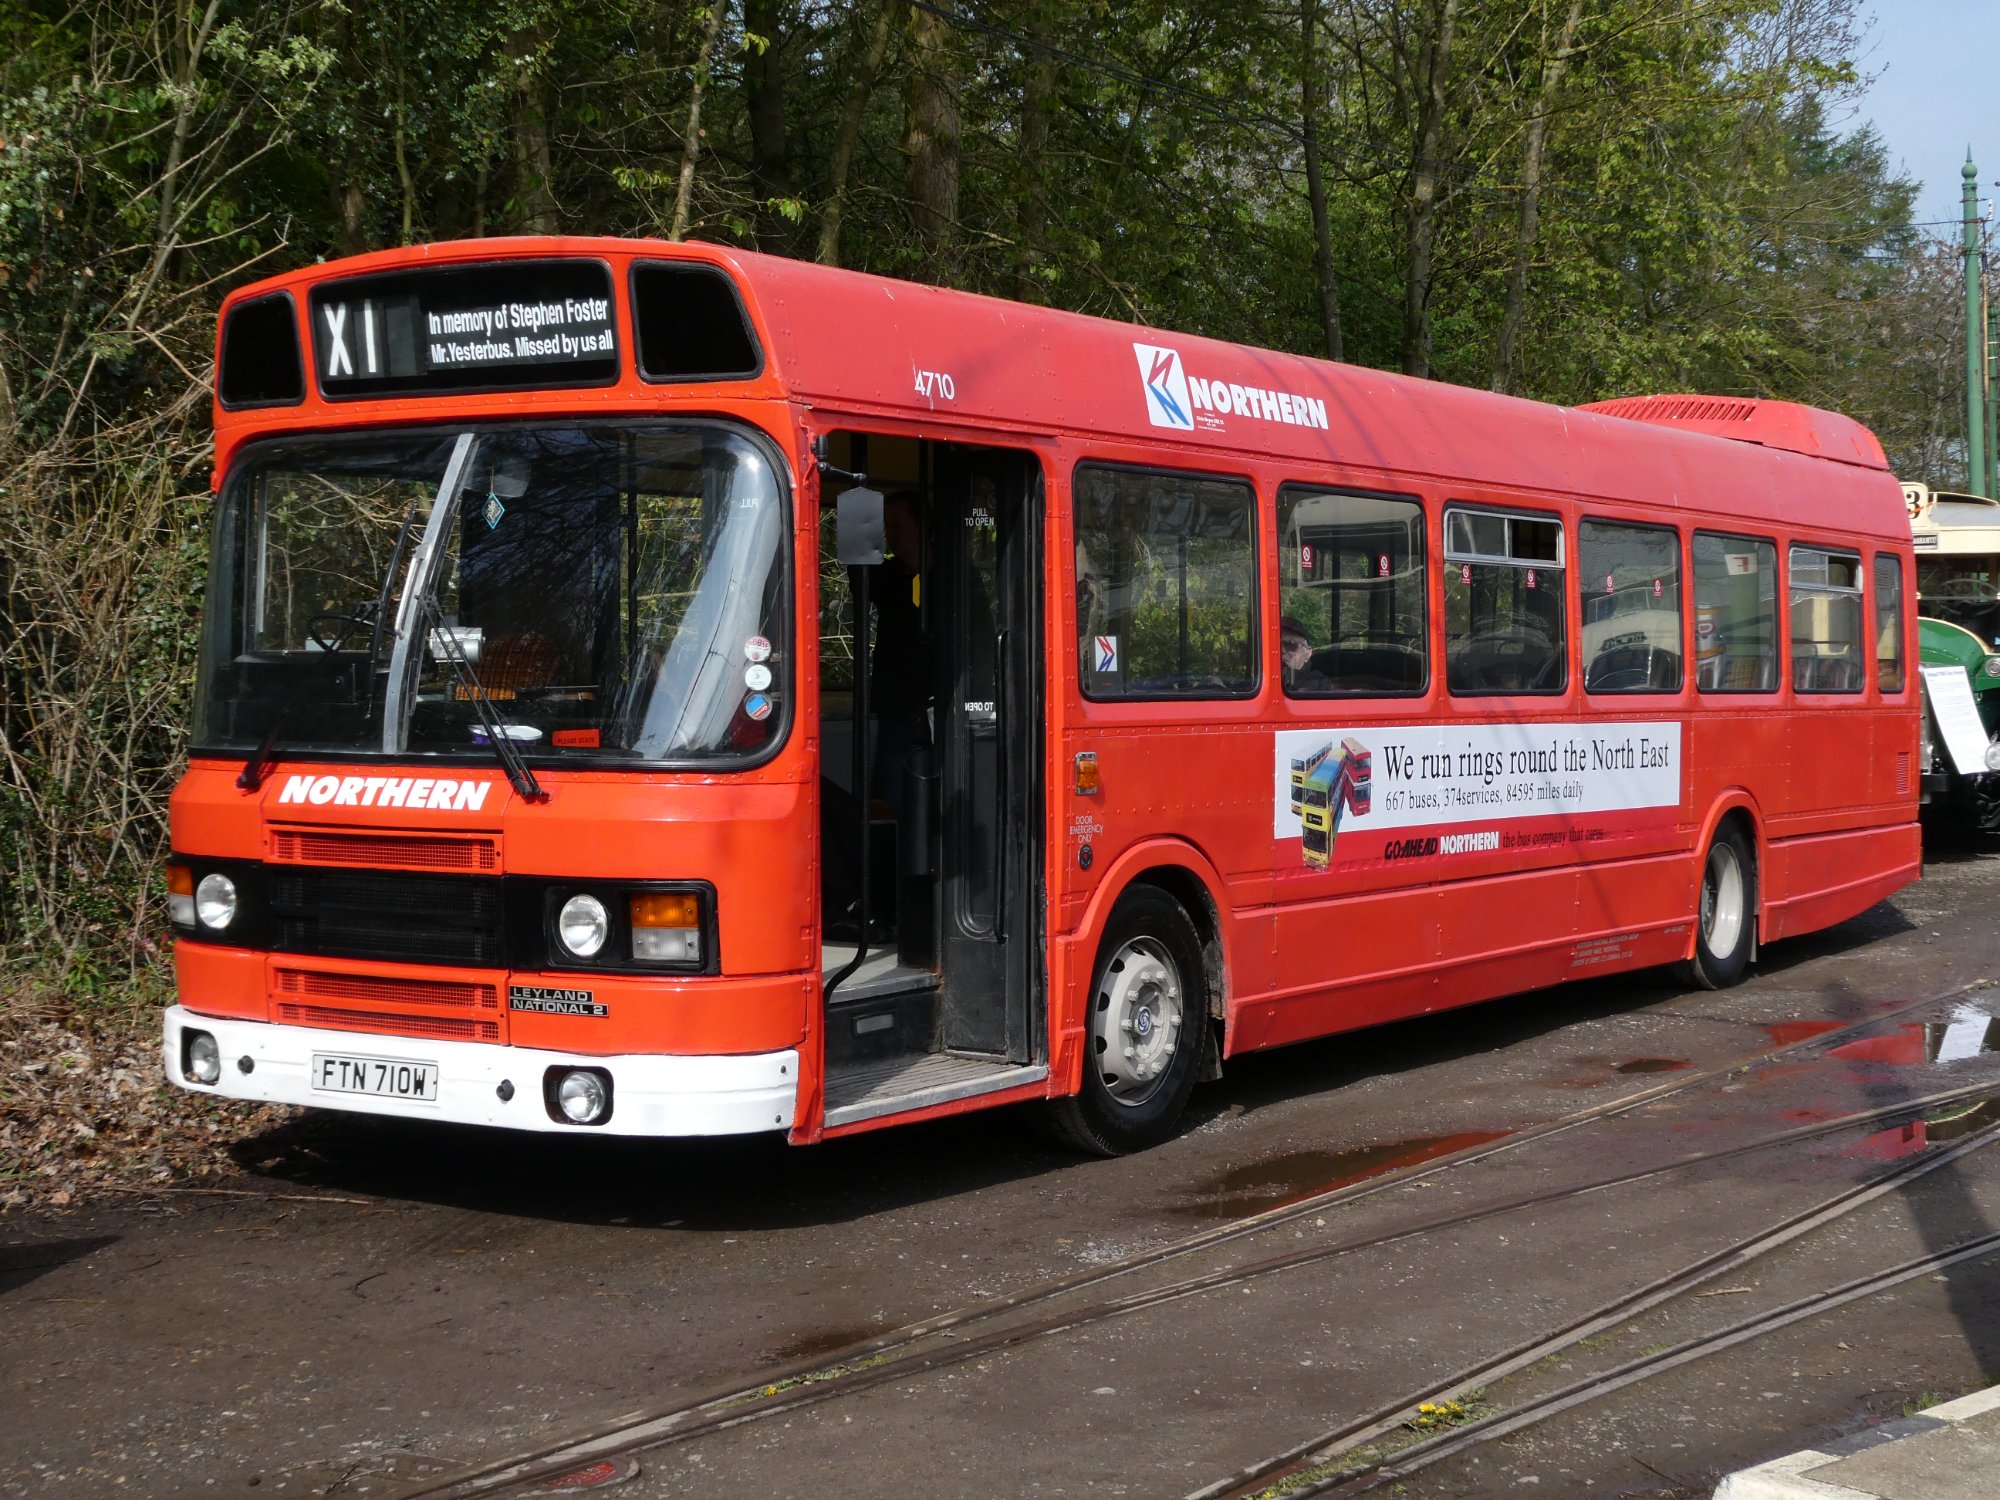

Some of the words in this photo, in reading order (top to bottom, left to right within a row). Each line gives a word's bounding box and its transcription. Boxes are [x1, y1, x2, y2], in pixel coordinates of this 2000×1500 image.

[428, 311, 441, 335] In
[444, 310, 492, 336] memory
[495, 304, 509, 329] of
[510, 301, 564, 333] Stephen
[565, 297, 608, 323] Foster
[515, 334, 560, 357] Missed
[561, 333, 579, 358] by
[581, 335, 597, 351] us
[599, 329, 614, 350] all
[913, 369, 955, 401] 4710
[1188, 376, 1329, 430] NORTHERN
[965, 517, 974, 527] TO
[975, 517, 995, 526] OPEN
[972, 508, 988, 517] PULL
[1384, 745, 1414, 782] We
[1421, 751, 1452, 780] run
[1458, 742, 1503, 785] rings
[1509, 740, 1557, 775] round
[1564, 739, 1586, 772] the
[1592, 738, 1634, 771] North
[1639, 738, 1669, 769] East
[278, 775, 491, 811] NORTHERN
[1385, 791, 1405, 811] 667
[1408, 791, 1441, 811] buses,
[1506, 783, 1534, 802] 84595
[1537, 780, 1560, 800] miles
[1563, 779, 1584, 802] daily
[1070, 824, 1104, 836] EMERGENCY
[1075, 815, 1093, 825] DOOR
[1078, 834, 1093, 844] ONLY
[1440, 831, 1500, 855] NORTHERN
[1503, 831, 1515, 848] the
[1517, 831, 1531, 846] bus
[1532, 831, 1567, 847] company
[1568, 826, 1584, 842] that
[513, 986, 588, 1002] LEYLAND
[513, 999, 588, 1014] NATIONAL
[593, 1005, 604, 1015] 2
[322, 1059, 366, 1090] FTN
[375, 1064, 426, 1096] 710W
